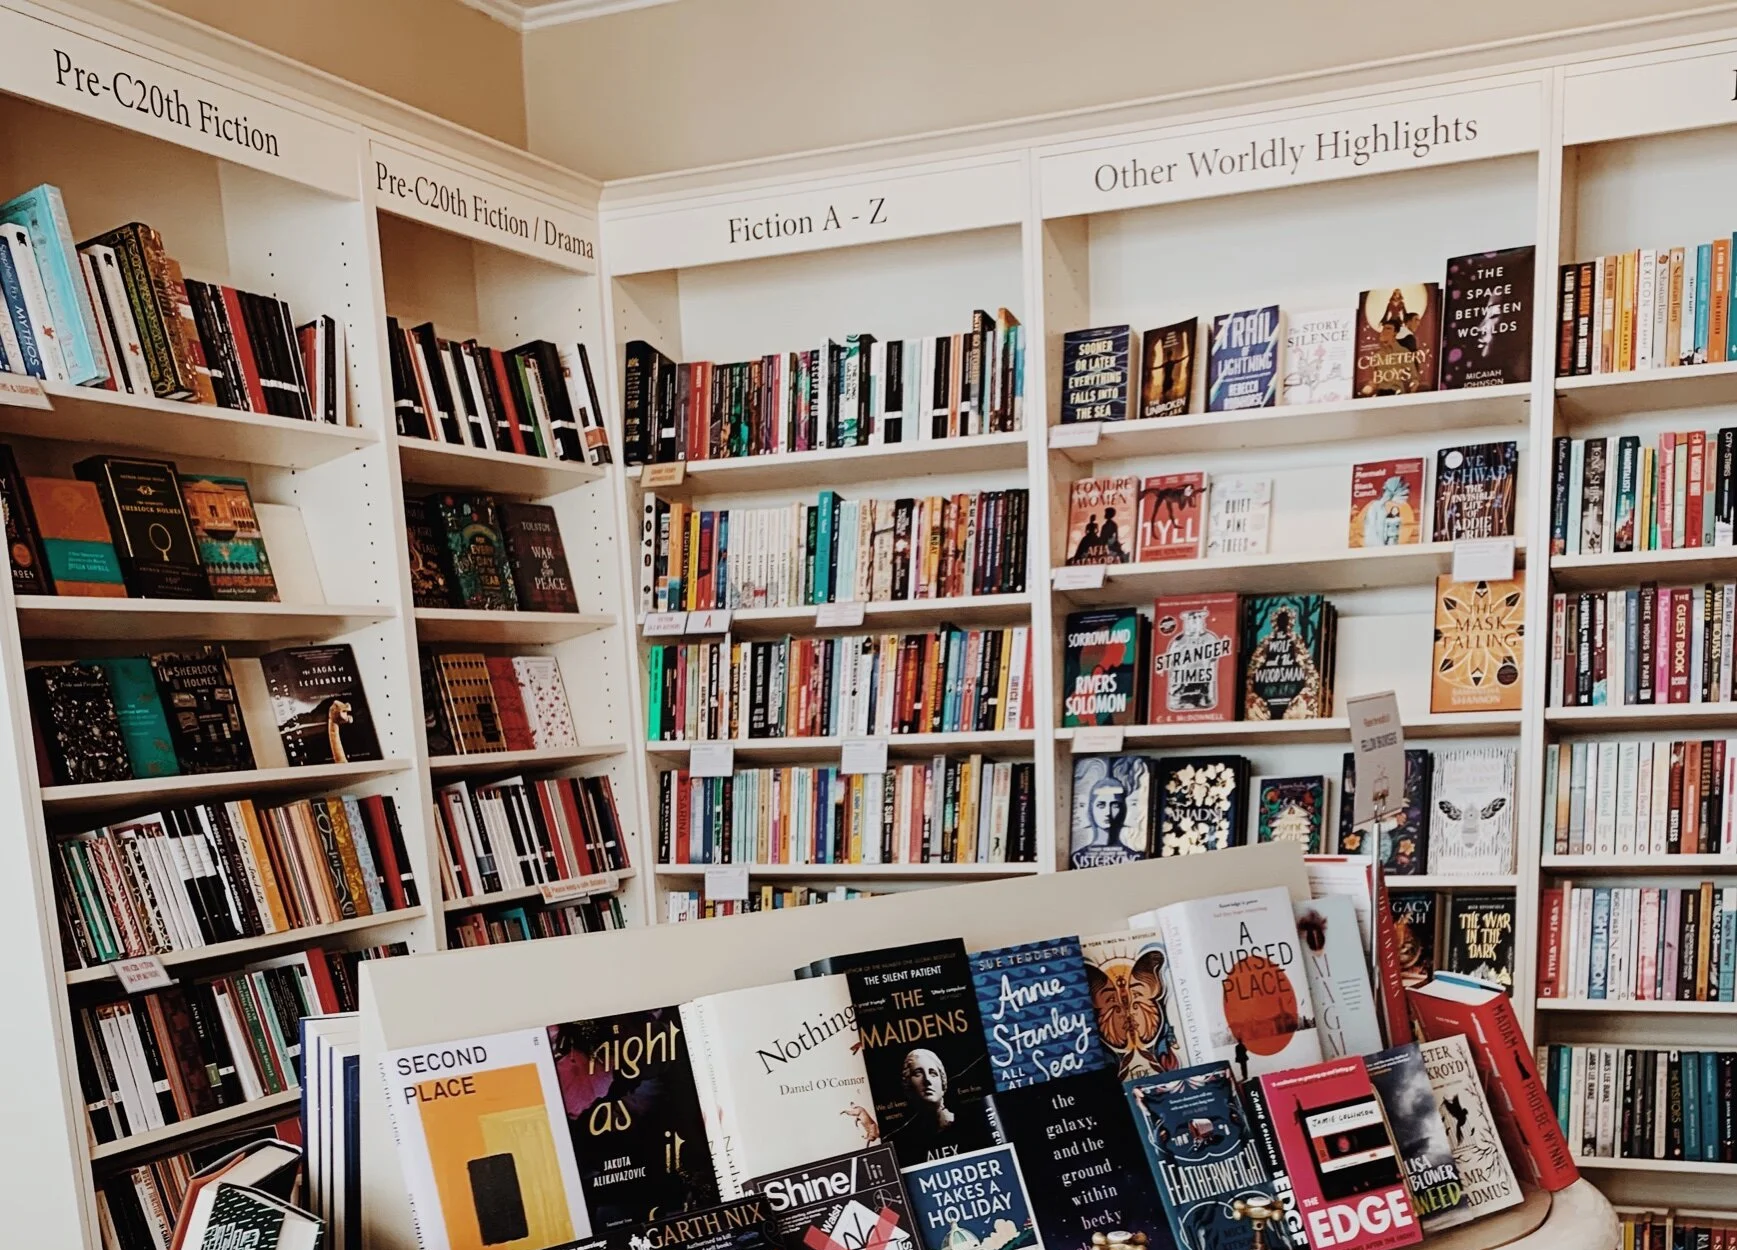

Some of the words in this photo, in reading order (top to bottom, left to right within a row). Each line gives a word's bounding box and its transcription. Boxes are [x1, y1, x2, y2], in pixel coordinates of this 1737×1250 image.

[53, 48, 192, 128] Pre-C20th
[198, 99, 280, 157] Fiction
[1094, 158, 1178, 193] Other
[1187, 137, 1305, 175] Worldly
[1315, 114, 1478, 166] Highlights
[376, 161, 468, 218] Pre-C20th
[473, 195, 529, 238] Fiction
[544, 219, 594, 259] Drama
[729, 212, 813, 244] Fiction
[823, 204, 842, 231] A
[868, 197, 888, 225] Z
[1477, 266, 1504, 279] THE
[1466, 284, 1512, 300] SPACE
[1455, 302, 1522, 320] BETWEEN
[15, 305, 40, 366] MYTHOS
[1218, 310, 1272, 349] TRAIL
[1303, 321, 1339, 333] STORY
[1457, 320, 1518, 339] WORLDS
[1078, 339, 1113, 355] SOONER
[1288, 329, 1348, 348] SILENCE
[1075, 358, 1087, 371] OR
[1088, 354, 1116, 371] LATER
[1217, 353, 1273, 376] LIGHTNING
[1357, 348, 1431, 371] CEMETERY
[1068, 371, 1122, 389] EVERYTHING
[1372, 367, 1411, 384] BOYS
[1466, 369, 1502, 380] MICAIAH
[1070, 391, 1096, 403] FALLS
[1076, 407, 1093, 419] THE
[1094, 404, 1112, 418] SEA
[1443, 465, 1507, 485] SCHWAB
[1075, 478, 1131, 495] CONJURE
[1077, 493, 1127, 509] WOMEN
[1455, 517, 1492, 530] ADDIE
[531, 546, 554, 560] WAR
[535, 578, 567, 592] PEACE
[1455, 616, 1506, 632] MASK
[1675, 604, 1687, 639] GUEST
[1068, 628, 1131, 648] SORROWLAND
[1268, 640, 1292, 653] WOLF
[1443, 632, 1517, 650] FALLING
[1156, 639, 1232, 671] STRANGER
[1674, 642, 1686, 673] BOOK
[174, 665, 218, 677] SHERLOCK
[1174, 668, 1213, 685] TIMES
[1255, 667, 1305, 683] WOODSMAN
[183, 677, 217, 688] HOLMES
[1075, 675, 1117, 695] RIVERS
[1065, 694, 1127, 716] SOLOMON
[679, 788, 687, 838] TSARINA
[1169, 808, 1224, 821] ARIADNE
[1459, 911, 1479, 930] THE
[1483, 911, 1511, 933] WAR
[1239, 921, 1253, 946] A
[1466, 929, 1478, 943] IN
[1480, 929, 1502, 945] THE
[1205, 941, 1293, 978] CURSED
[1468, 945, 1496, 961] DARK
[979, 958, 1002, 971] SUE
[864, 975, 880, 986] THE
[882, 970, 910, 983] SILENT
[911, 965, 942, 979] PATIENT
[1222, 969, 1291, 1002] PLACE
[891, 989, 925, 1010] THE
[992, 966, 1065, 1020] Annie
[860, 1008, 969, 1050] MAIDENS
[991, 1007, 1092, 1067] Stanley
[1492, 1004, 1518, 1050] MADAM
[589, 1020, 681, 1079] night
[755, 1003, 858, 1075] Nothing
[397, 1046, 488, 1076] SECOND
[1422, 1046, 1452, 1063] ETER
[1001, 1066, 1026, 1081] ALL
[1032, 1050, 1084, 1081] Sea
[1427, 1061, 1464, 1080] KROYD
[403, 1076, 477, 1105] PLACE
[780, 1082, 813, 1096] Daniel
[816, 1075, 865, 1090] O'Connor
[1052, 1094, 1076, 1110] the
[589, 1100, 632, 1136] as
[1311, 1116, 1336, 1128] JAMIE
[1339, 1109, 1374, 1124] COLLINSON
[1524, 1082, 1550, 1131] PHOEBE
[1543, 1130, 1570, 1174] WYNNE
[664, 1131, 685, 1174] it
[927, 1144, 959, 1159] ALEX
[1053, 1142, 1081, 1161] and
[1082, 1137, 1105, 1152] the
[604, 1156, 631, 1171] JAKUTA
[1061, 1158, 1113, 1187] ground
[1158, 1139, 1268, 1206] FEATHERWEIGHT
[1250, 1090, 1263, 1121] JAMIE
[1259, 1122, 1278, 1166] COLLINSON
[1272, 1176, 1309, 1246] EDGE
[1404, 1155, 1432, 1175] LISA
[593, 1167, 646, 1187] ALIKAVAZOVIC
[918, 1159, 1004, 1193] MURDER
[1410, 1165, 1458, 1192] BLOWER
[1464, 1168, 1489, 1188] MR
[932, 1184, 985, 1208] TAKES
[989, 1180, 1001, 1193] A
[1071, 1184, 1118, 1207] within
[1303, 1197, 1320, 1208] THE
[820, 1203, 844, 1234] Walsh
[927, 1192, 1013, 1229] HOLIDAY
[1081, 1207, 1123, 1232] becky
[1307, 1189, 1413, 1249] EDGE
[647, 1212, 722, 1249] GARTH
[724, 1202, 766, 1230] NIX
[716, 1242, 733, 1250] books
